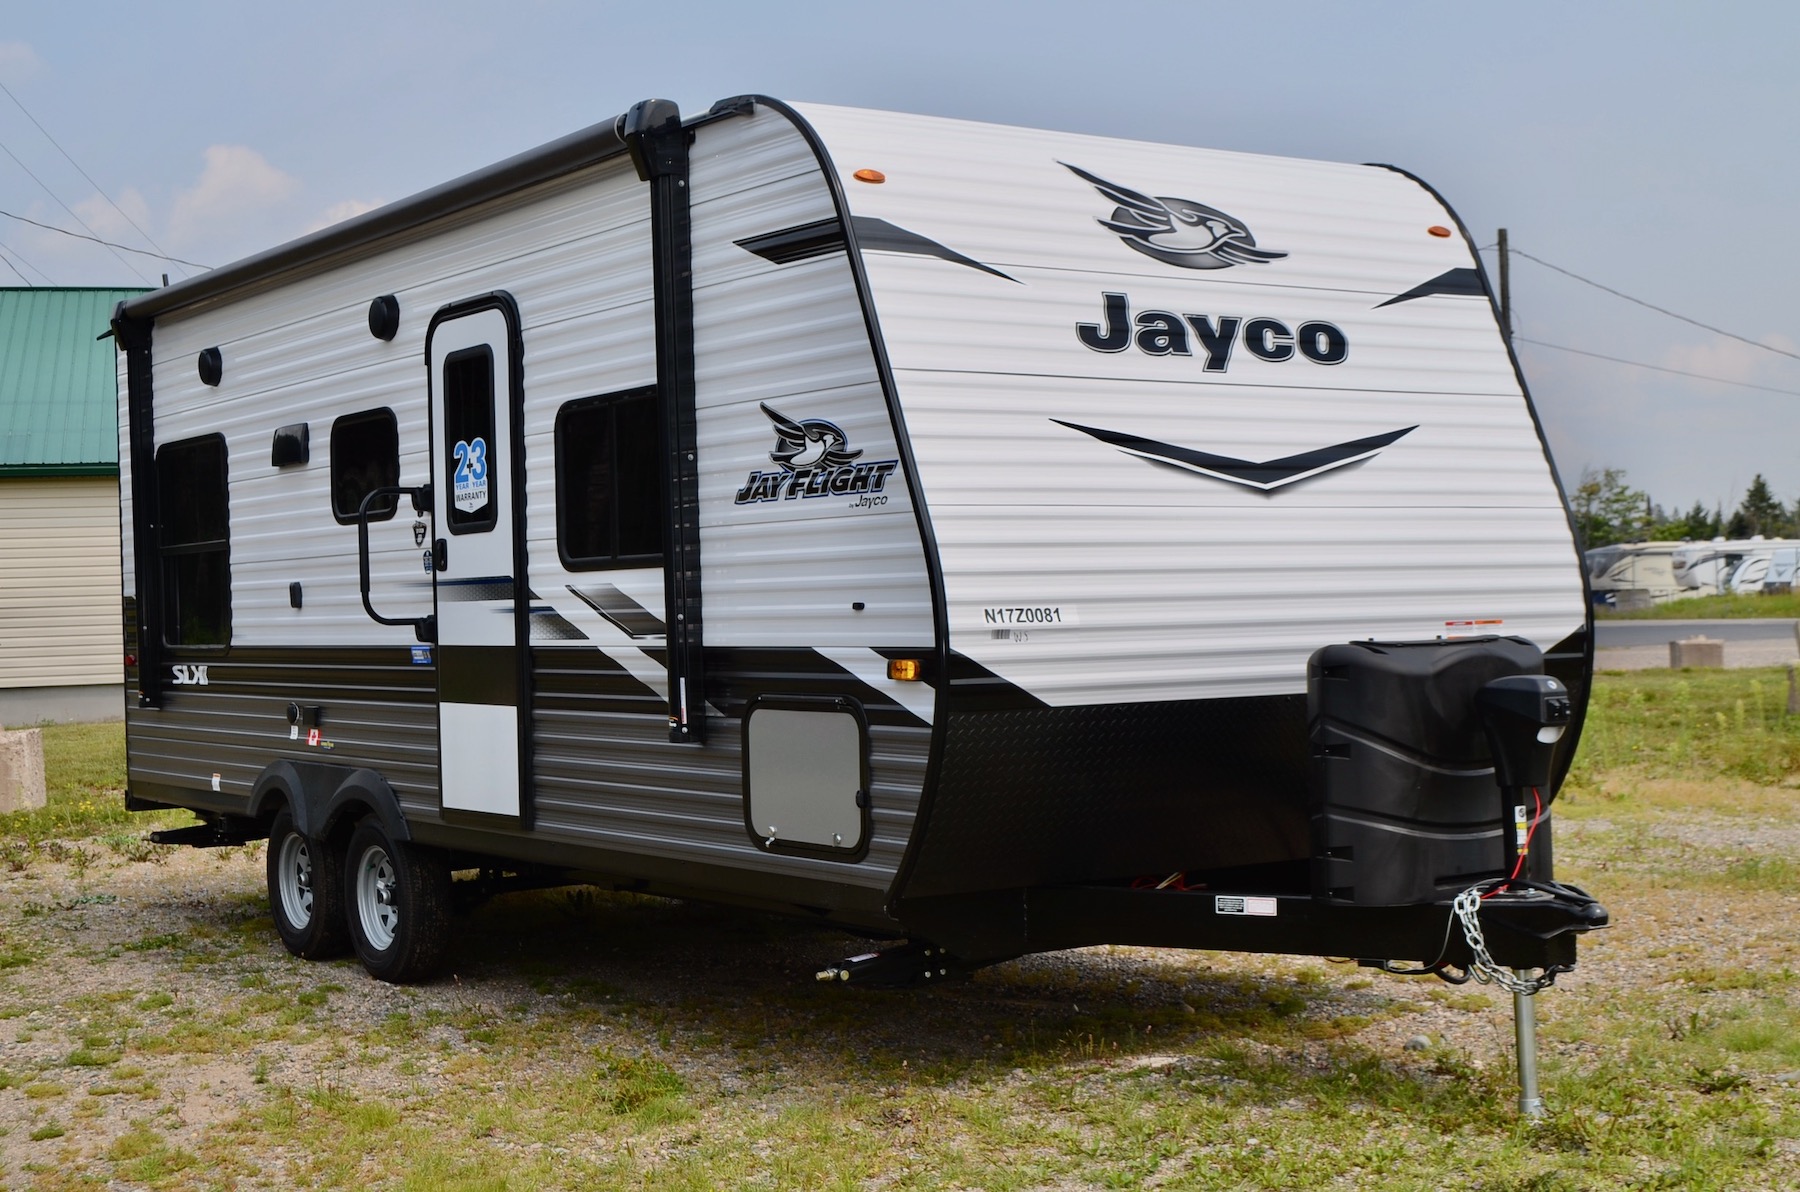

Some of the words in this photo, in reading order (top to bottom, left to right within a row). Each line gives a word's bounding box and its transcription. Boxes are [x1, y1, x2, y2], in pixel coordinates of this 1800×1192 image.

[1076, 291, 1349, 373] Jayco
[472, 480, 486, 488] YEAR
[735, 471, 794, 505] JAY
[785, 460, 899, 500] FLIGHT
[456, 491, 486, 502] WARRANTY
[855, 495, 888, 509] Jayco
[984, 608, 1061, 624] N17Z0081
